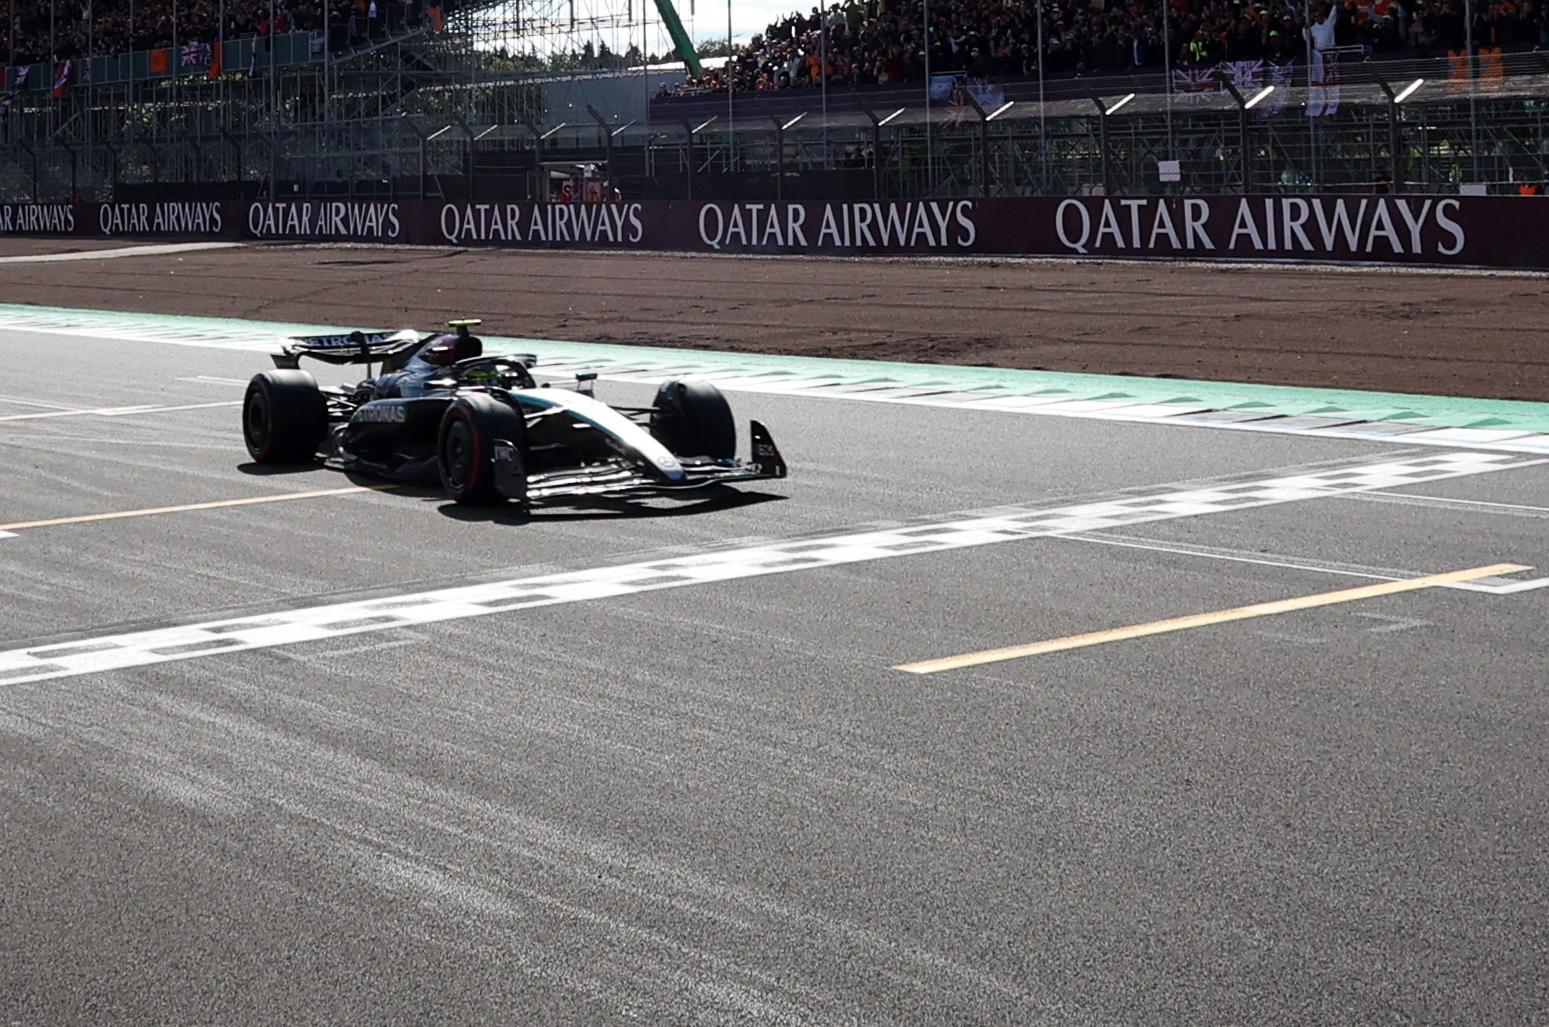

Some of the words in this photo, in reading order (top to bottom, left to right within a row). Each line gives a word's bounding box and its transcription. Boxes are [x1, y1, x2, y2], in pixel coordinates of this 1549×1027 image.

[16, 204, 74, 232] AIRWAYS
[100, 203, 148, 235] QATAR
[153, 202, 222, 232] AIRWAYS
[249, 202, 311, 238] QATAR
[315, 202, 399, 238] AIRWAYS
[440, 203, 522, 245] QATAR
[528, 203, 643, 243] AIRWAYS
[699, 203, 808, 249] QATAR
[818, 200, 976, 247] AIRWAYS
[1056, 198, 1215, 254] QATAR
[1229, 198, 1466, 255] AIRWAYS
